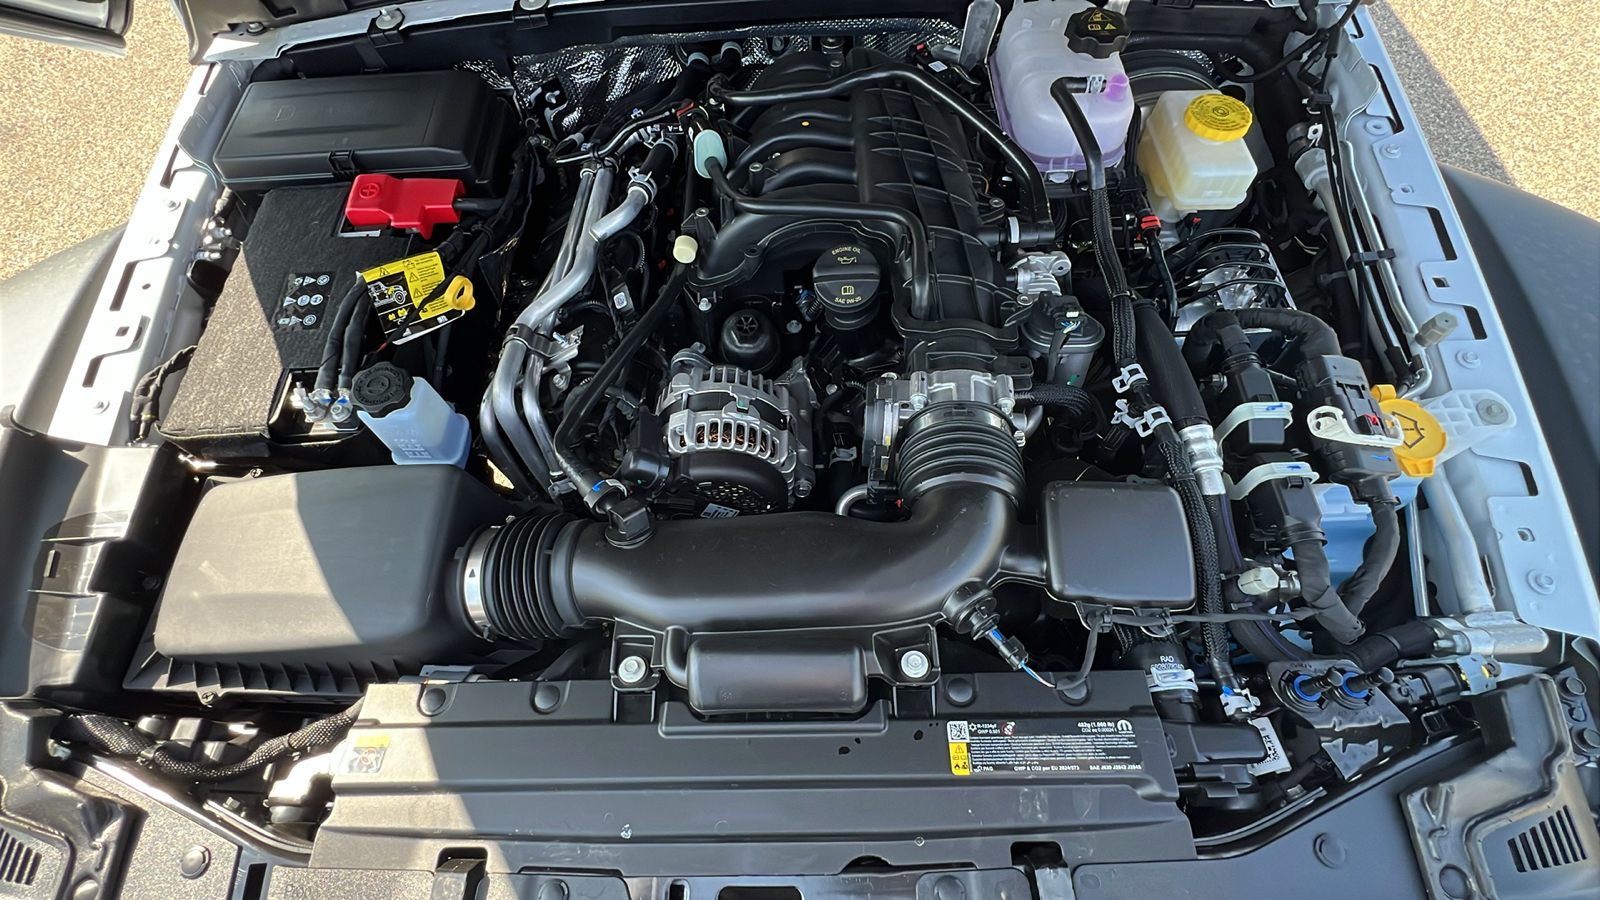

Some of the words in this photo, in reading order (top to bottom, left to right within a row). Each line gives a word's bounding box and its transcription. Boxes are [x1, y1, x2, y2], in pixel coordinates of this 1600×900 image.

[831, 246, 852, 255] ENGINE
[834, 296, 846, 304] SAE
[846, 295, 862, 304] 0W-20
